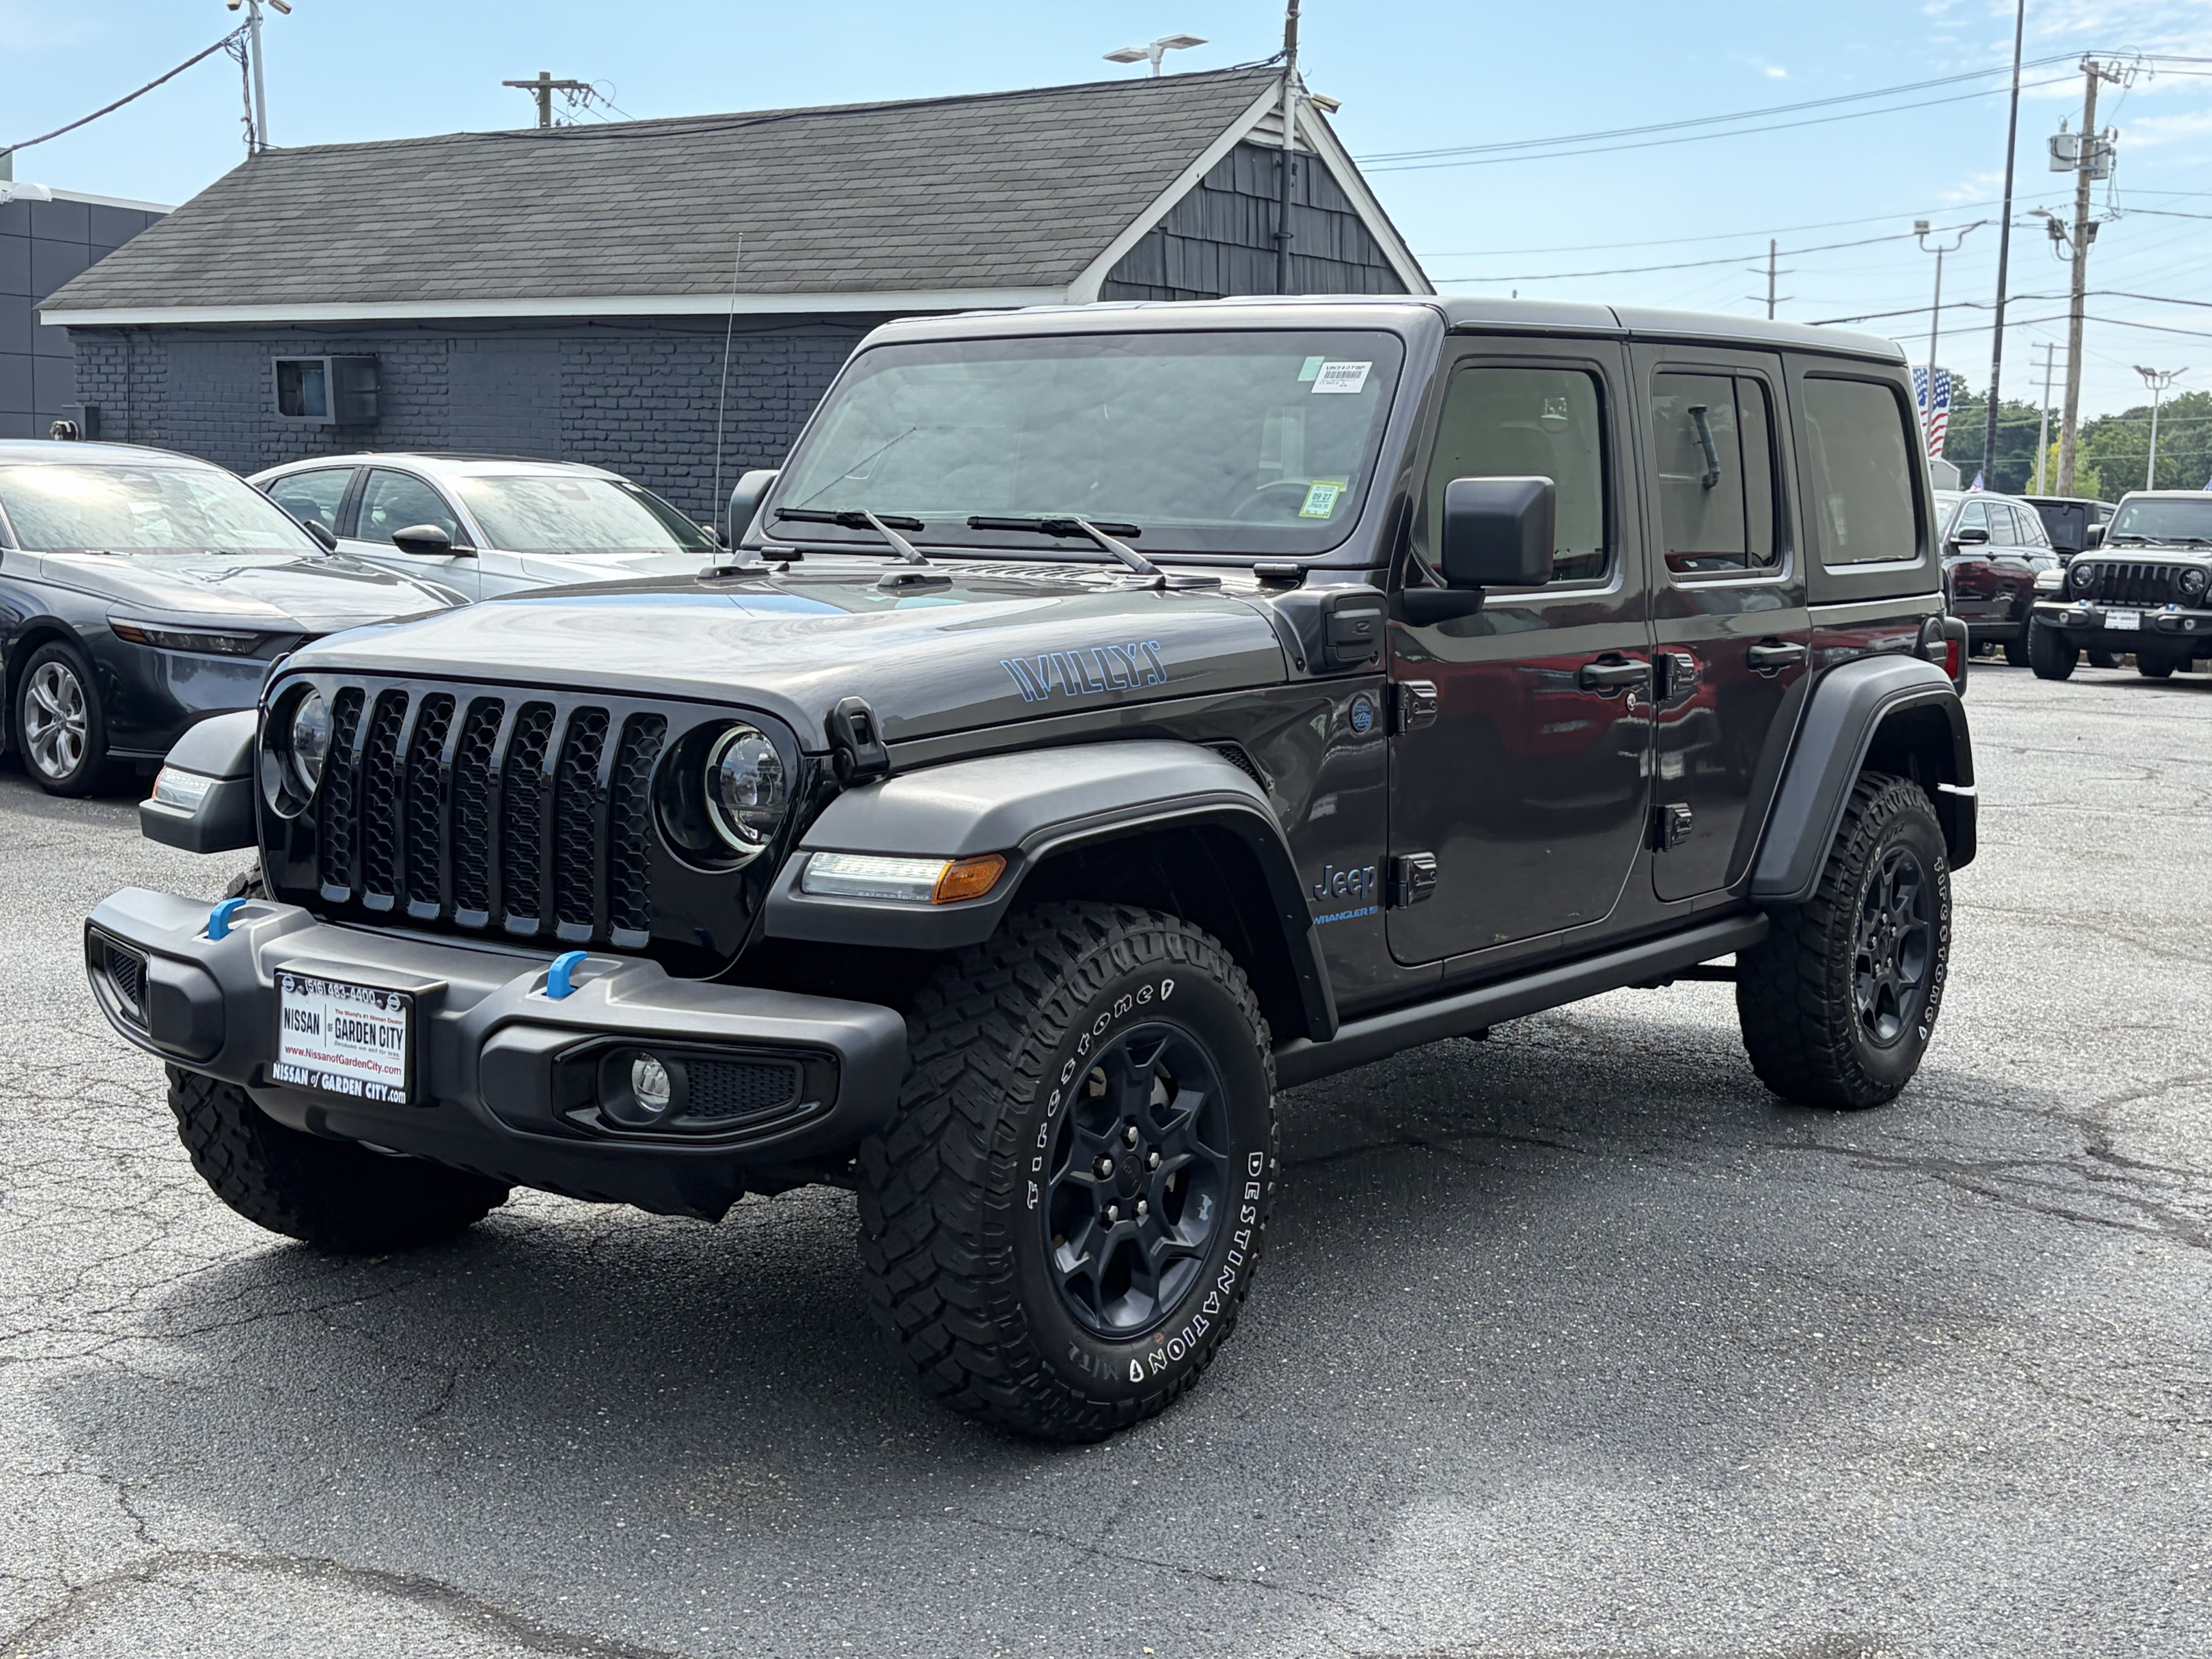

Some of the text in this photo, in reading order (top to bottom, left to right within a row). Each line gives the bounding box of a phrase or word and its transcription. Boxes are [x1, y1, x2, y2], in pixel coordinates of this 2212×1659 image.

[1000, 640, 1167, 702] WILLYS
[1314, 864, 1375, 901] Jeep
[1313, 907, 1368, 925] WRANGLER
[328, 983, 376, 1004] 483-4400
[284, 1007, 320, 1036] NISSAN
[335, 1017, 376, 1046] GARDEN
[379, 1025, 404, 1051] CITY
[285, 1046, 402, 1075] www.NissanofGardenCity.com
[273, 1063, 406, 1104] NISSAN of GARDEN CITY.com
[1147, 1152, 1264, 1377] DESTINATION
